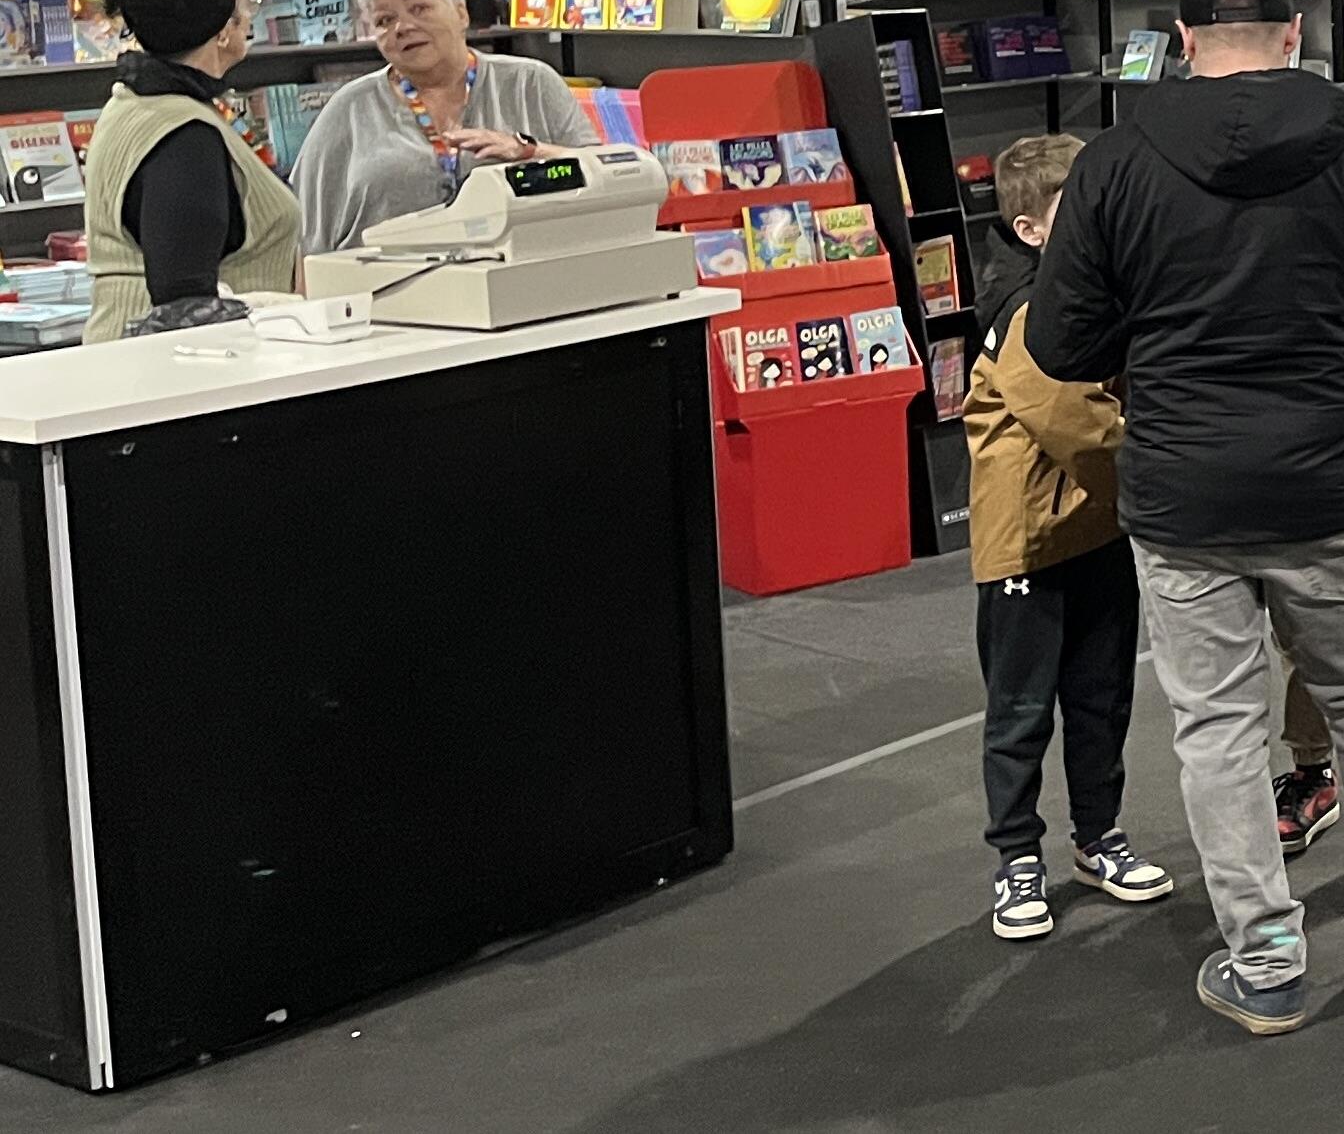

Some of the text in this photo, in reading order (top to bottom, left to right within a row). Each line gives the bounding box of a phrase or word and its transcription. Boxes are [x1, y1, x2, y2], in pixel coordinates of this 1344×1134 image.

[857, 313, 896, 332] OLGA
[745, 327, 789, 346] OLGA
[800, 323, 839, 343] OLGA
